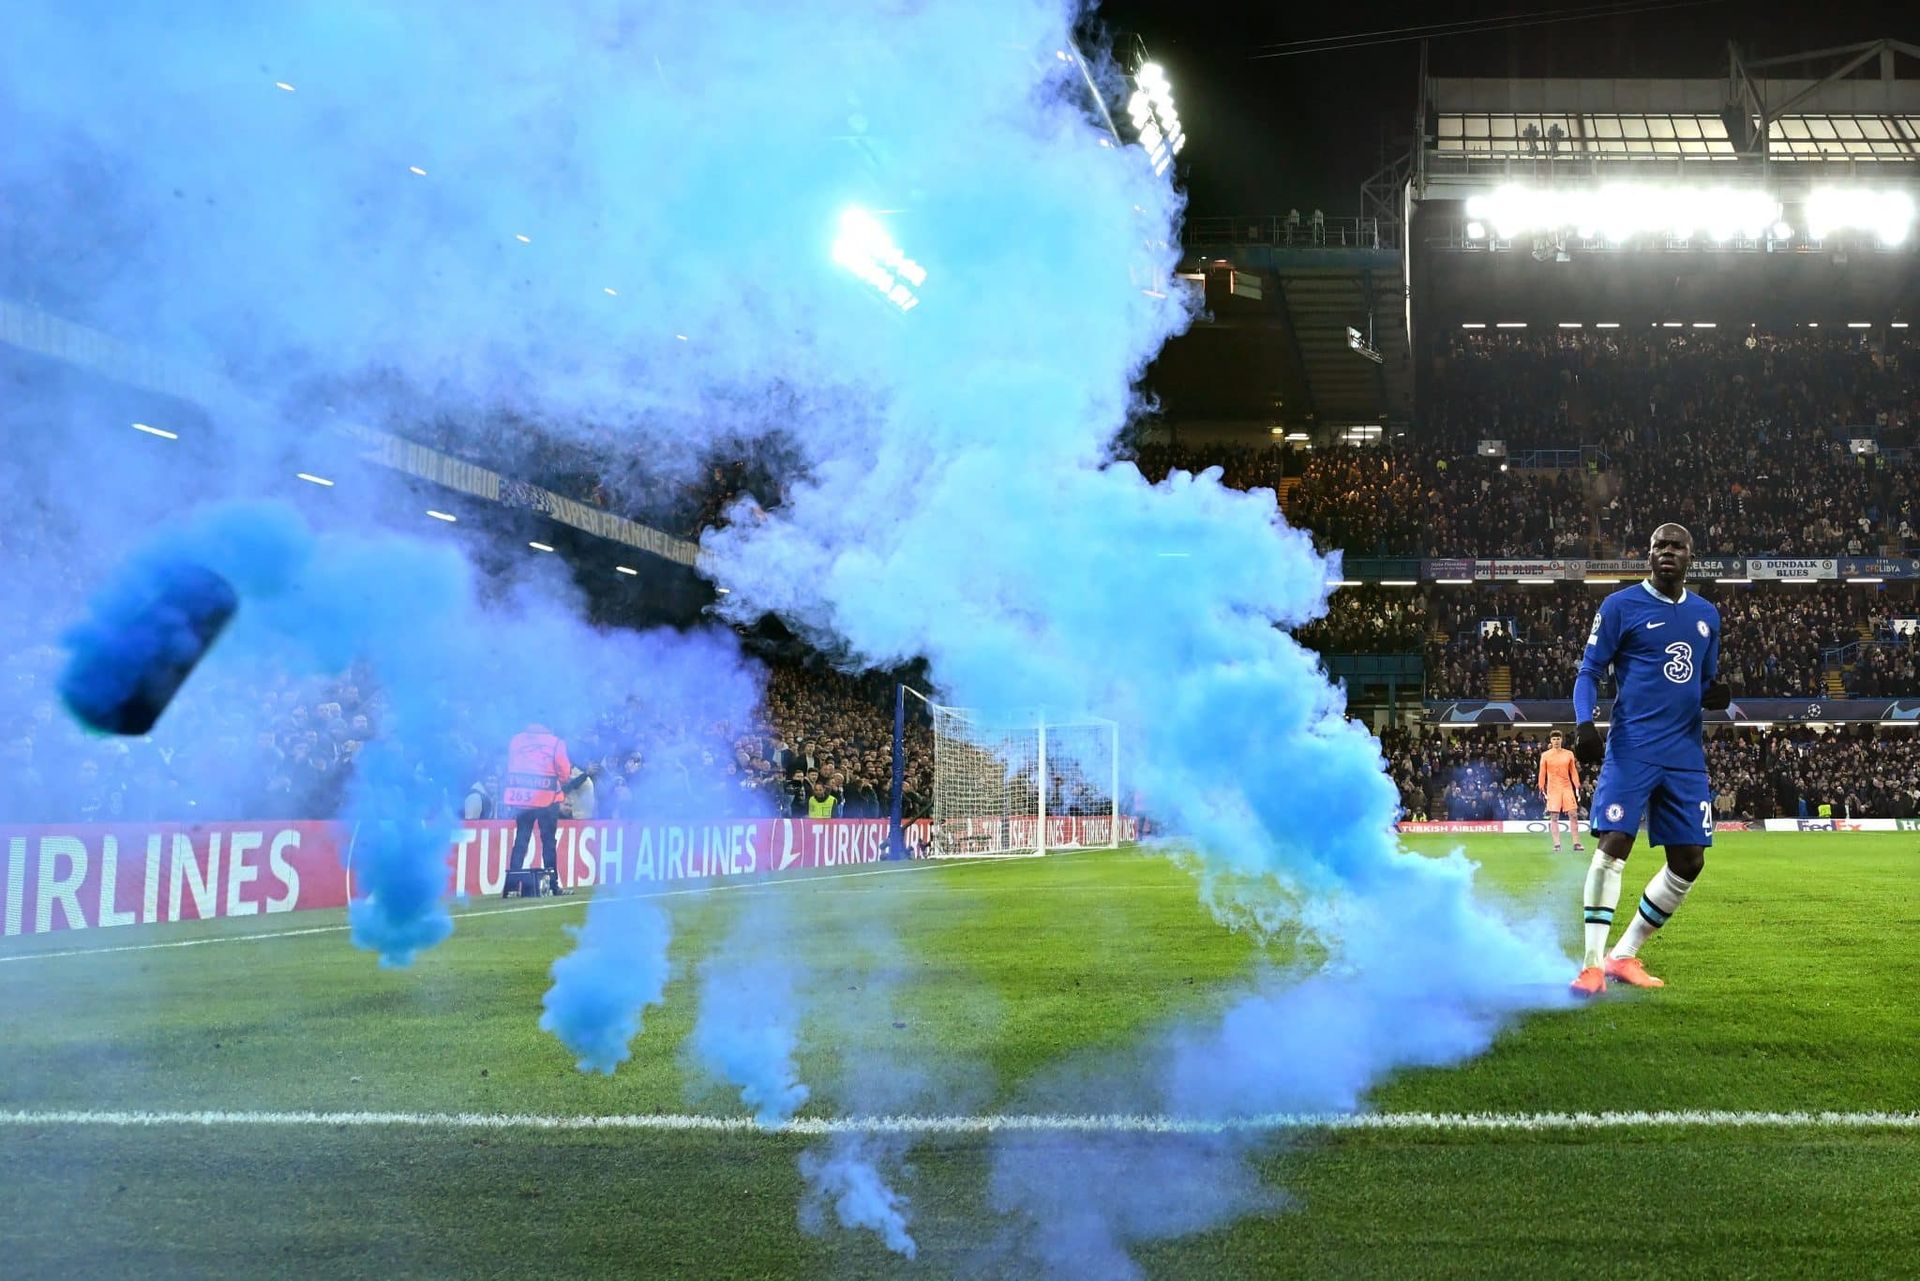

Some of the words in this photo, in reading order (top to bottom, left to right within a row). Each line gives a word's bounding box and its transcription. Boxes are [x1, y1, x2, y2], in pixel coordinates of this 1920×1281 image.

[550, 492, 598, 536] SUPER
[601, 514, 664, 556] FRANKIE
[1585, 560, 1619, 570] German
[1621, 560, 1646, 569] Blues
[1687, 561, 1724, 570] ELSEA
[1766, 560, 1818, 569] DUNDALK
[1776, 569, 1809, 577] BLUES
[1663, 641, 1694, 684] 3
[1699, 801, 1713, 829] 2
[1402, 825, 1448, 833] TURKISH
[1450, 825, 1499, 833] AIRLINES
[1799, 819, 1862, 832] FedEx
[451, 826, 623, 897] TUISH
[634, 824, 757, 881] AIRLINES
